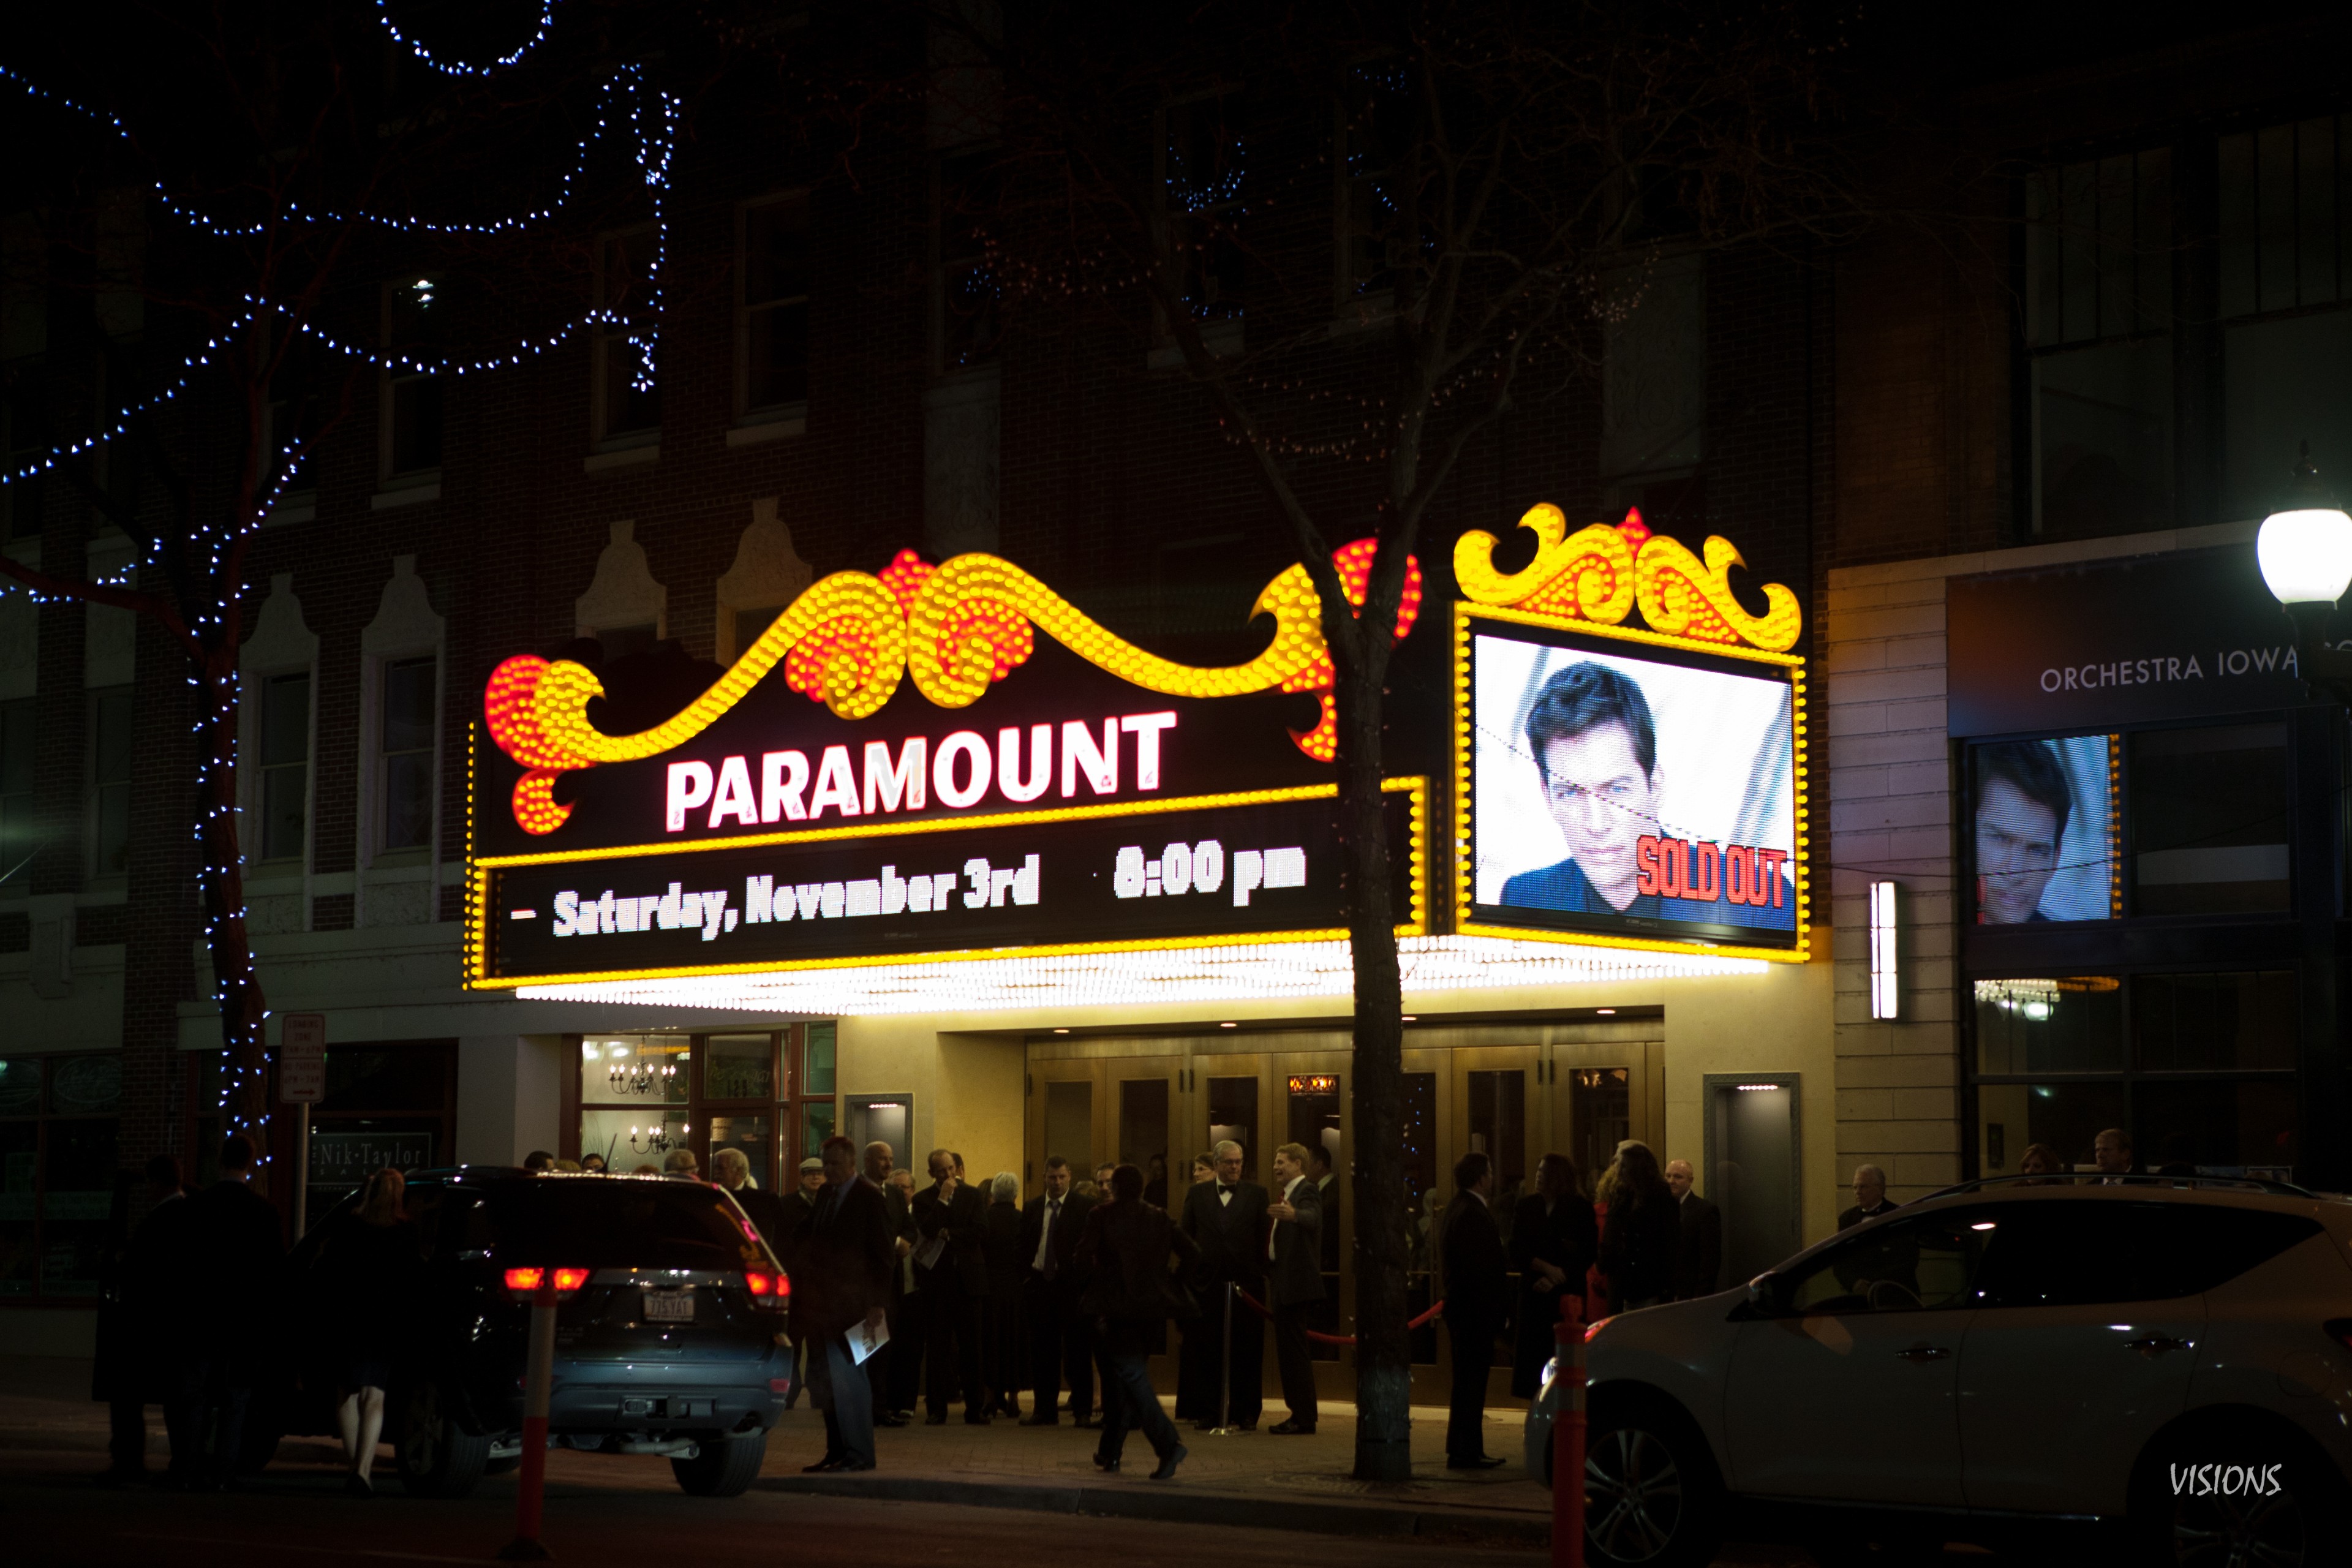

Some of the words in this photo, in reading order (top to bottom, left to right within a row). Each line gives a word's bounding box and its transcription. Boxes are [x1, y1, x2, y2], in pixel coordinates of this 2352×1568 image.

[2040, 655, 2203, 692] ORCHESTRA
[2218, 645, 2299, 679] IOWA
[665, 710, 1177, 832] PARAMOUNT
[552, 882, 739, 941] Saturday,
[745, 865, 957, 924] November
[963, 854, 1040, 909] 3rd
[1113, 840, 1224, 899] 8:00
[1233, 846, 1306, 907] pm
[1637, 835, 1721, 902] SOLD
[1726, 845, 1787, 908] OUT
[288, 1020, 319, 1029] LOADING
[294, 1032, 311, 1041] ZONE
[284, 1061, 293, 1071] NO
[295, 1061, 321, 1071] PARKING
